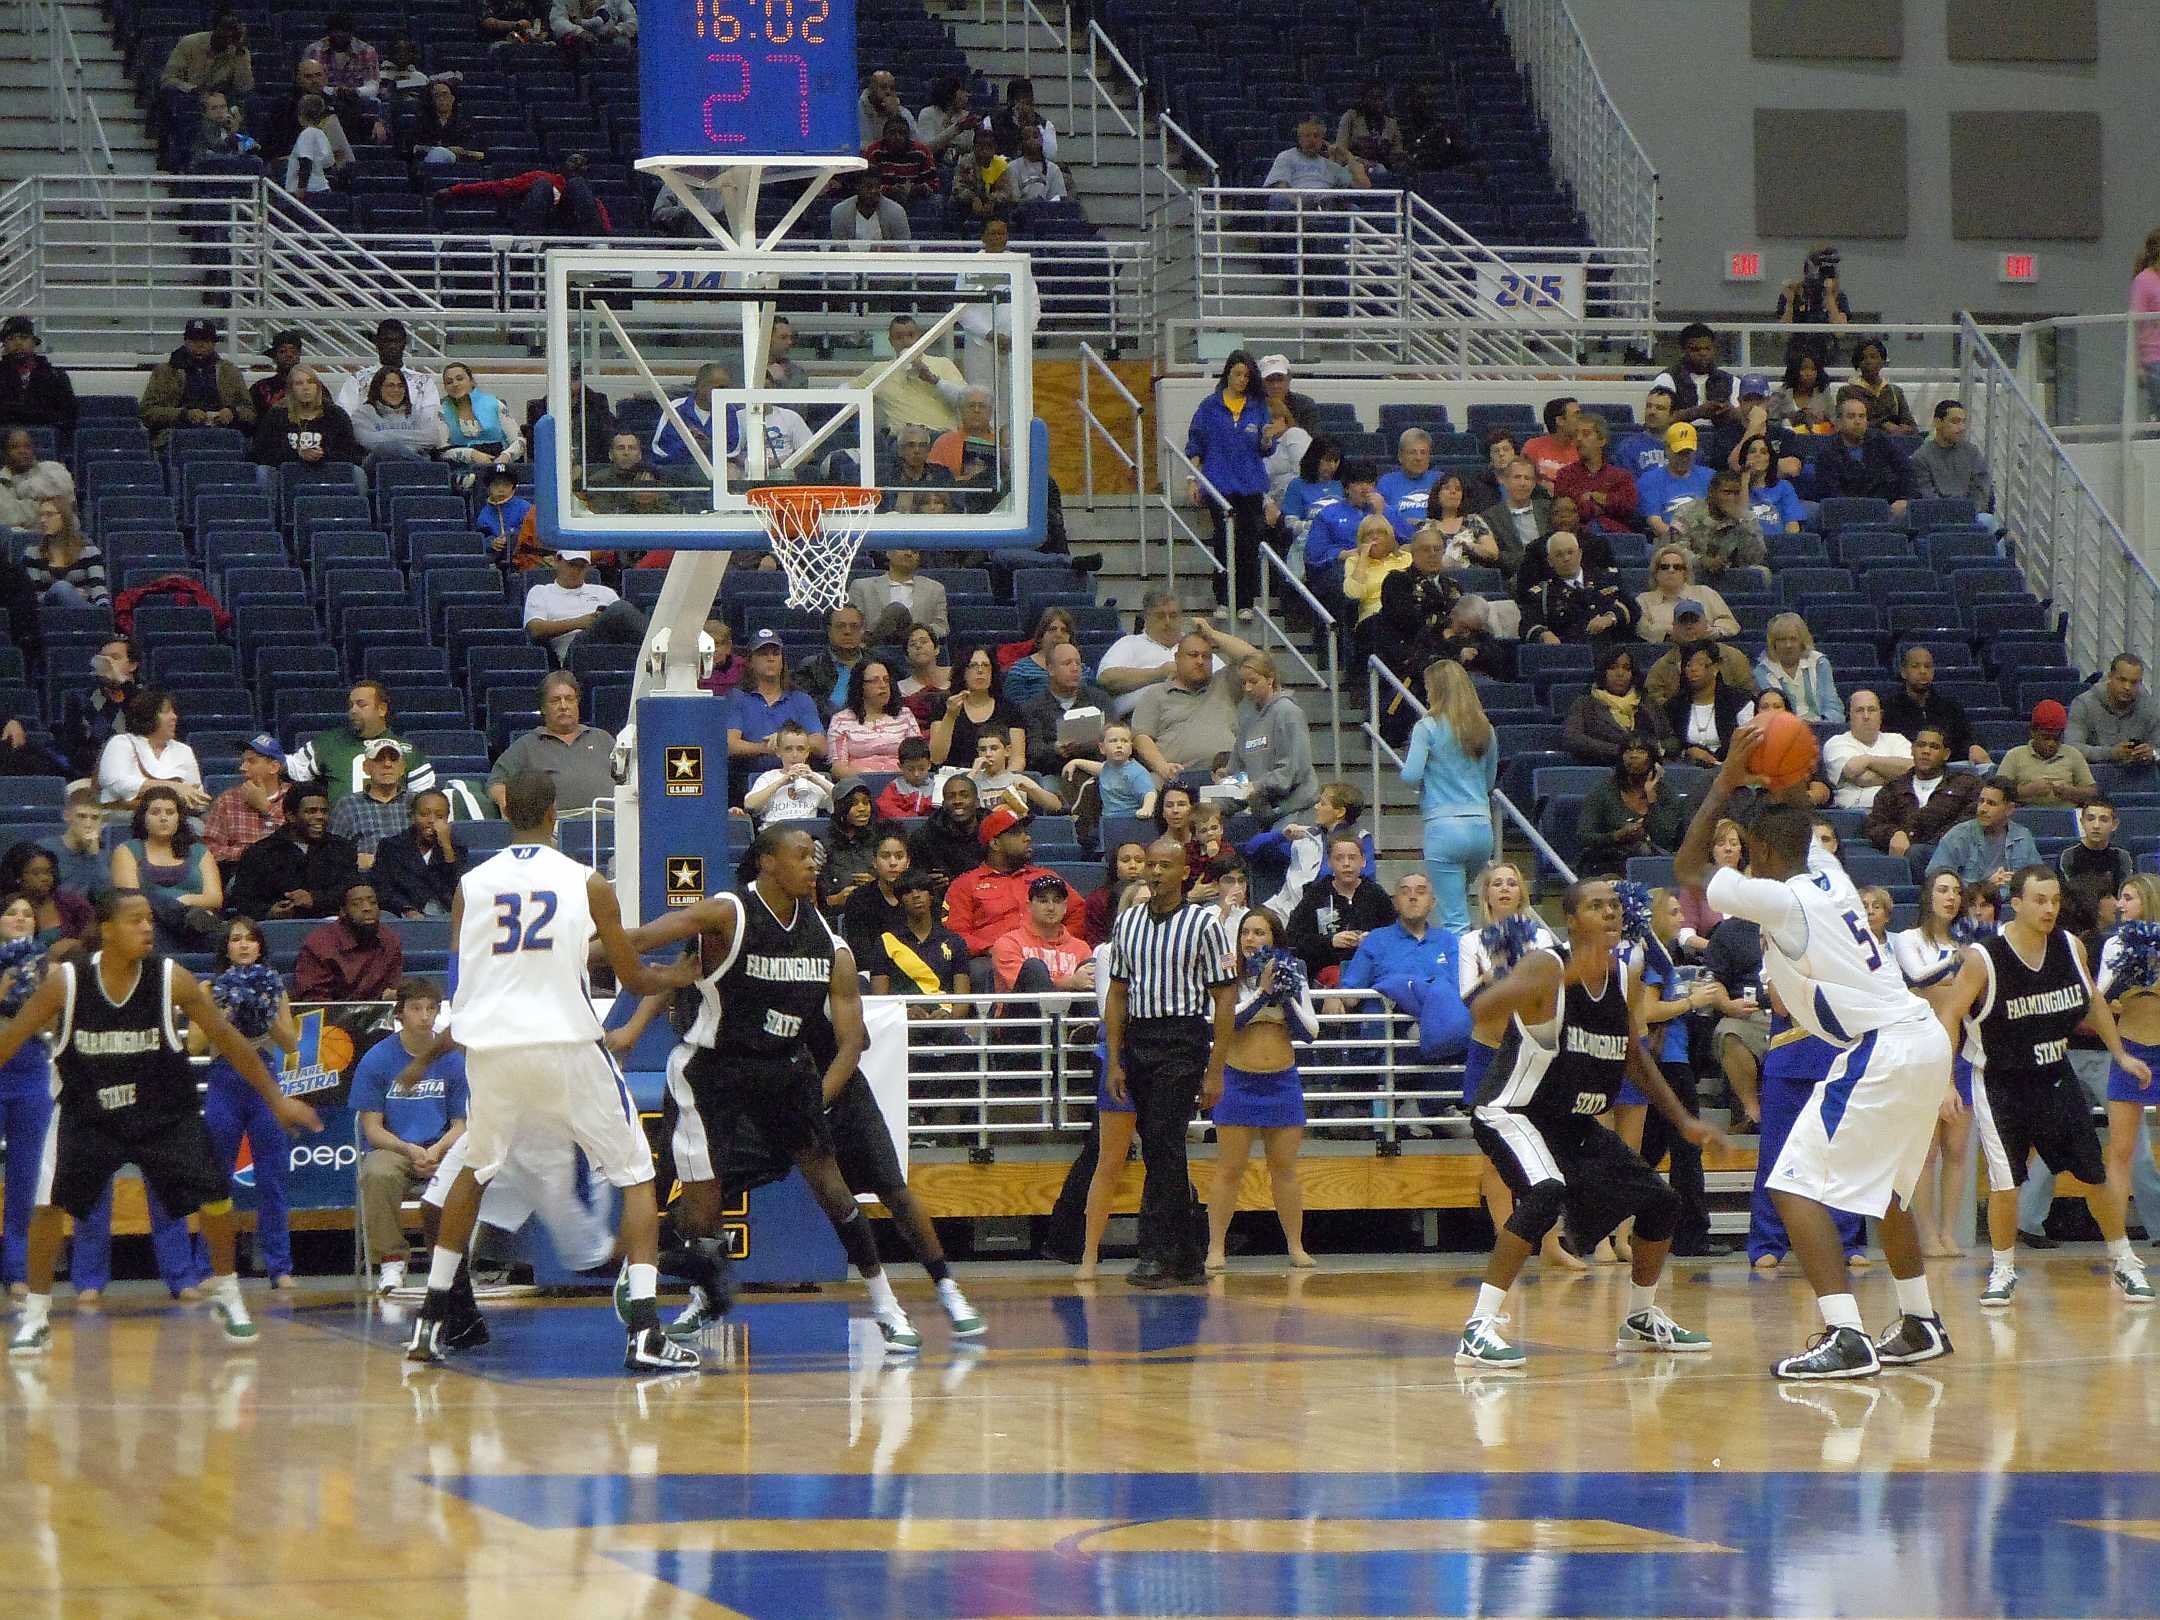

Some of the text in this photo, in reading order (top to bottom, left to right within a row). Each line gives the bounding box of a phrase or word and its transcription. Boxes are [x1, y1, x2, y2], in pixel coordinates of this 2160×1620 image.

[703, 54, 808, 142] 27
[1733, 254, 1759, 275] EXIT
[2007, 254, 2033, 276] EXIT
[1495, 275, 1563, 307] 215
[492, 890, 558, 955] 32
[1841, 910, 1883, 973] 5
[745, 954, 831, 983] FARMINGDALE
[2006, 983, 2084, 1020] FARMINGDALE
[281, 1070, 339, 1098] OFSTRA
[289, 1144, 357, 1172] pep
